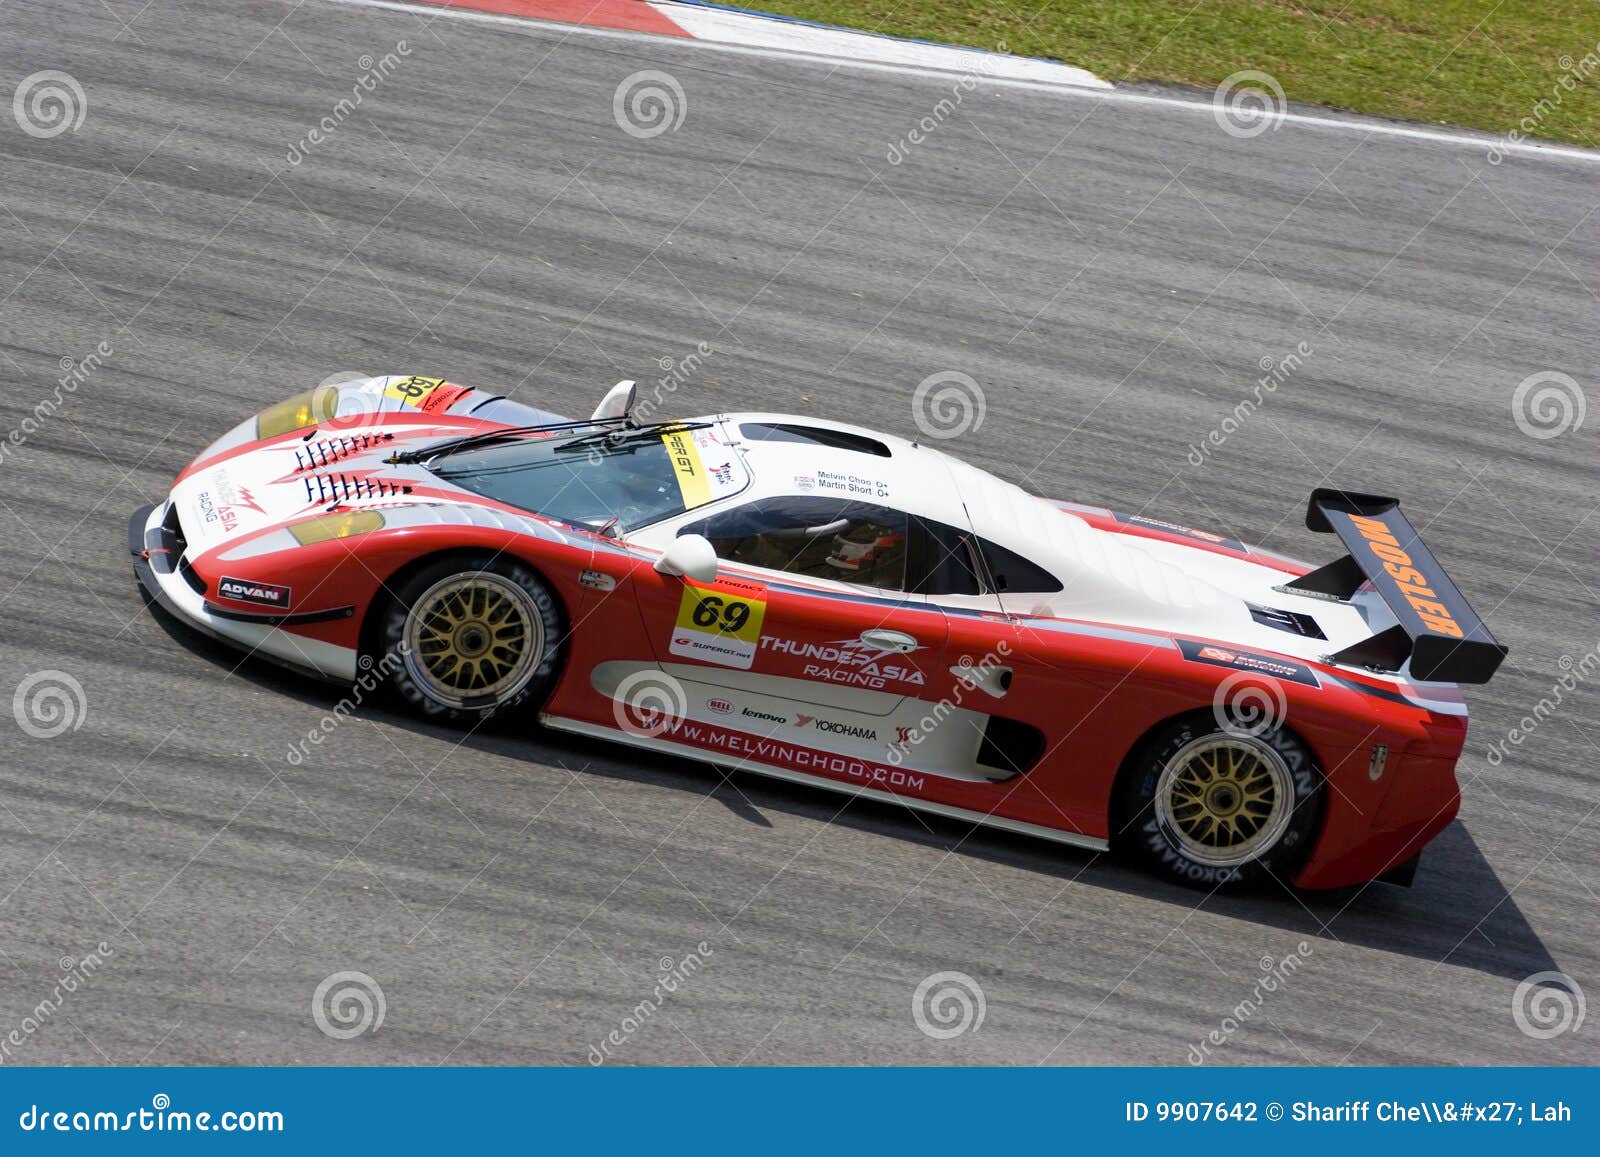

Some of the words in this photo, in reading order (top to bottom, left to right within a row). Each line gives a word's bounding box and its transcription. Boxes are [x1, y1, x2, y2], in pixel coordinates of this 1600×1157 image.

[817, 470, 846, 481] Melvin
[818, 479, 846, 490] Martin
[848, 483, 872, 496] Short
[1347, 512, 1465, 638] MOSLER
[221, 582, 279, 600] ADVAN
[692, 596, 750, 633] 69
[803, 664, 887, 689] RACING
[709, 699, 732, 712] BELL
[741, 707, 787, 724] lenovo
[814, 719, 878, 741] YOKOHAMA
